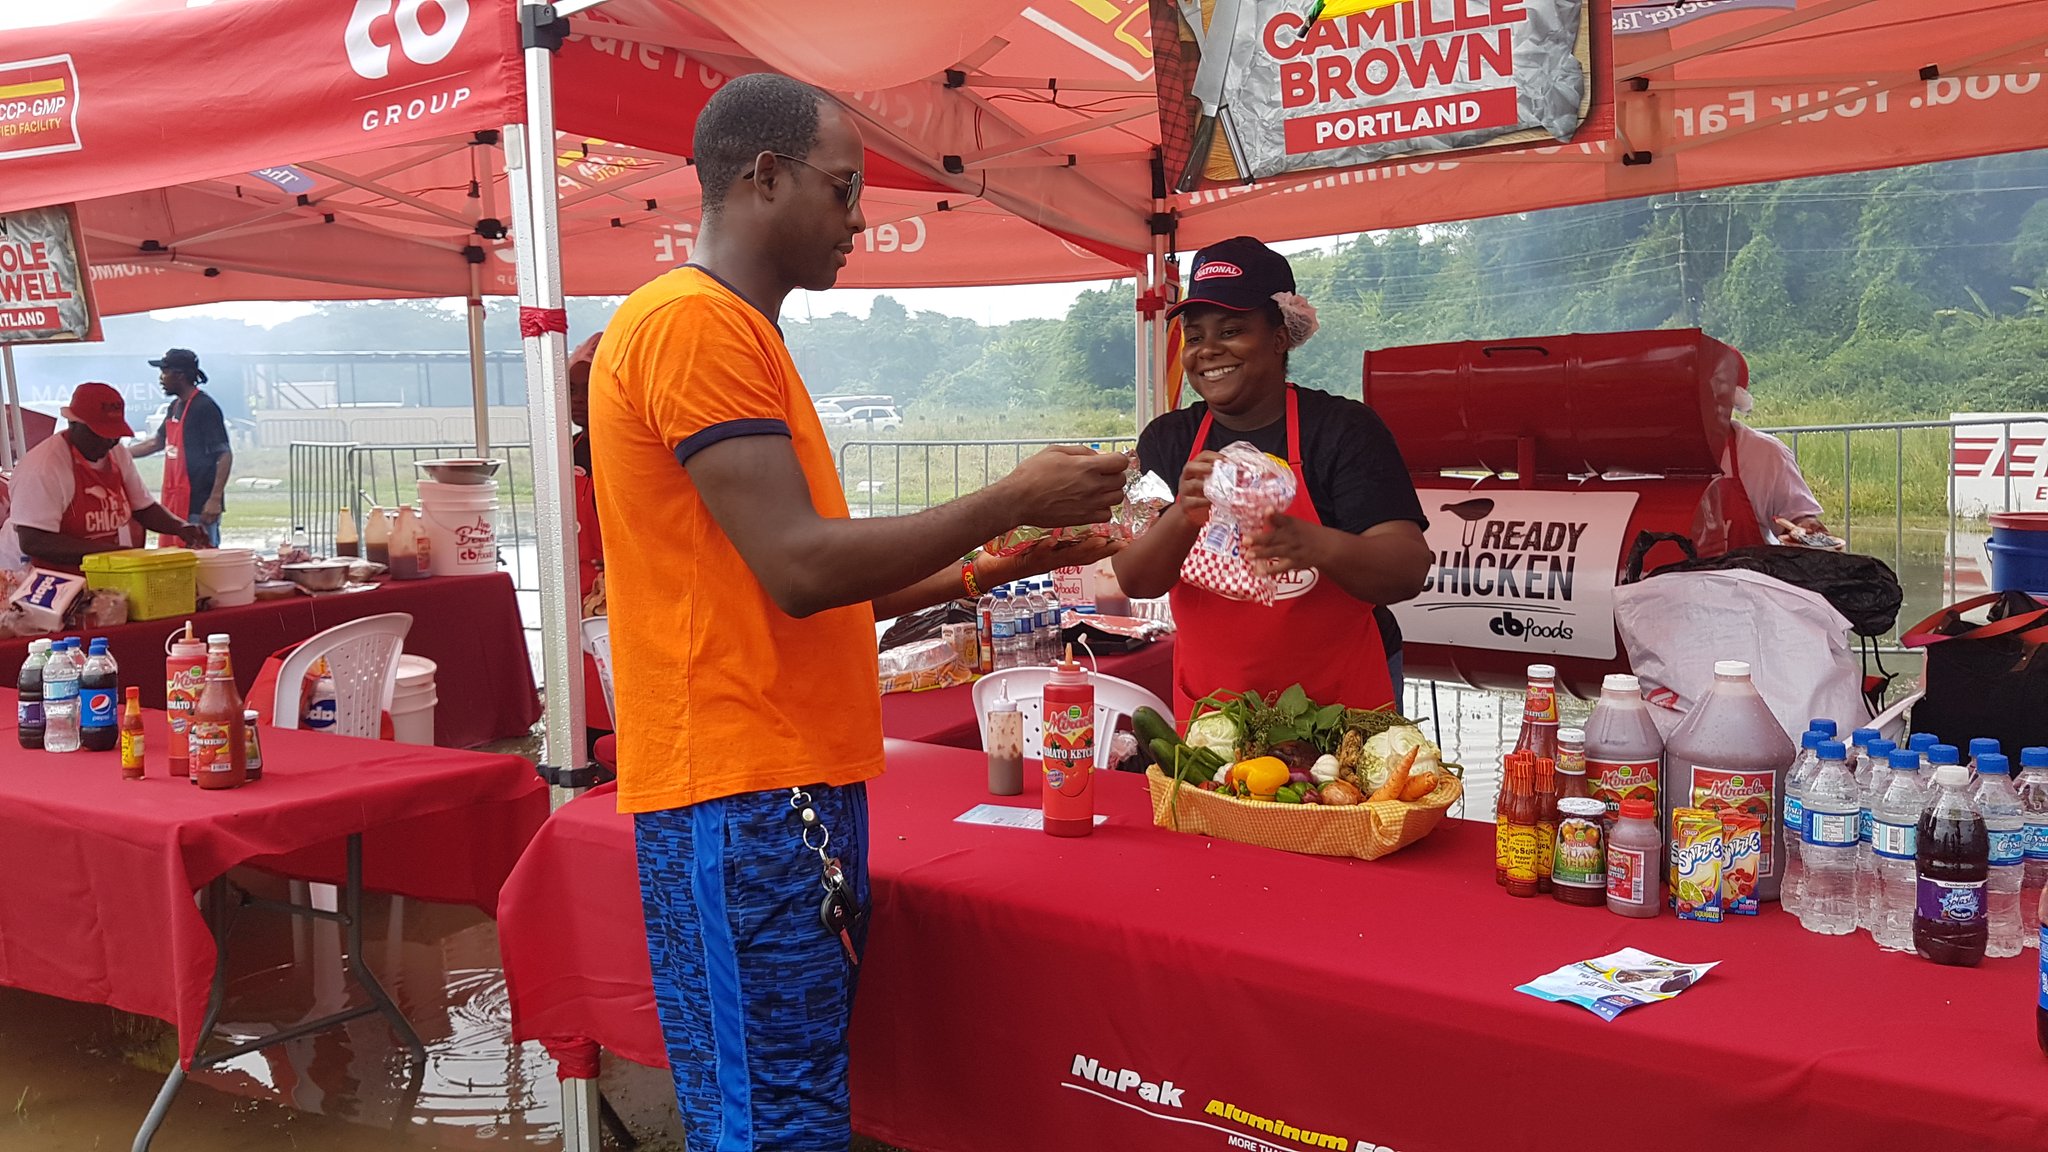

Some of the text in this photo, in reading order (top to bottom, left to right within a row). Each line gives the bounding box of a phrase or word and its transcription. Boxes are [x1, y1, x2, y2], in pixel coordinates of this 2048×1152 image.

[1263, 0, 1527, 59] CAMILLE
[1279, 28, 1513, 109] BROWN
[19, 118, 62, 134] FACILITY
[362, 87, 471, 131] GROUP
[1315, 100, 1482, 144] PORTLAND
[1481, 520, 1588, 552] READY
[1598, 766, 1652, 790] Miracle
[1703, 779, 1767, 799] Miracle
[1071, 1054, 1186, 1108] NuPak
[1204, 1099, 1349, 1152] Aluminum
[1228, 1135, 1257, 1152] MORE
